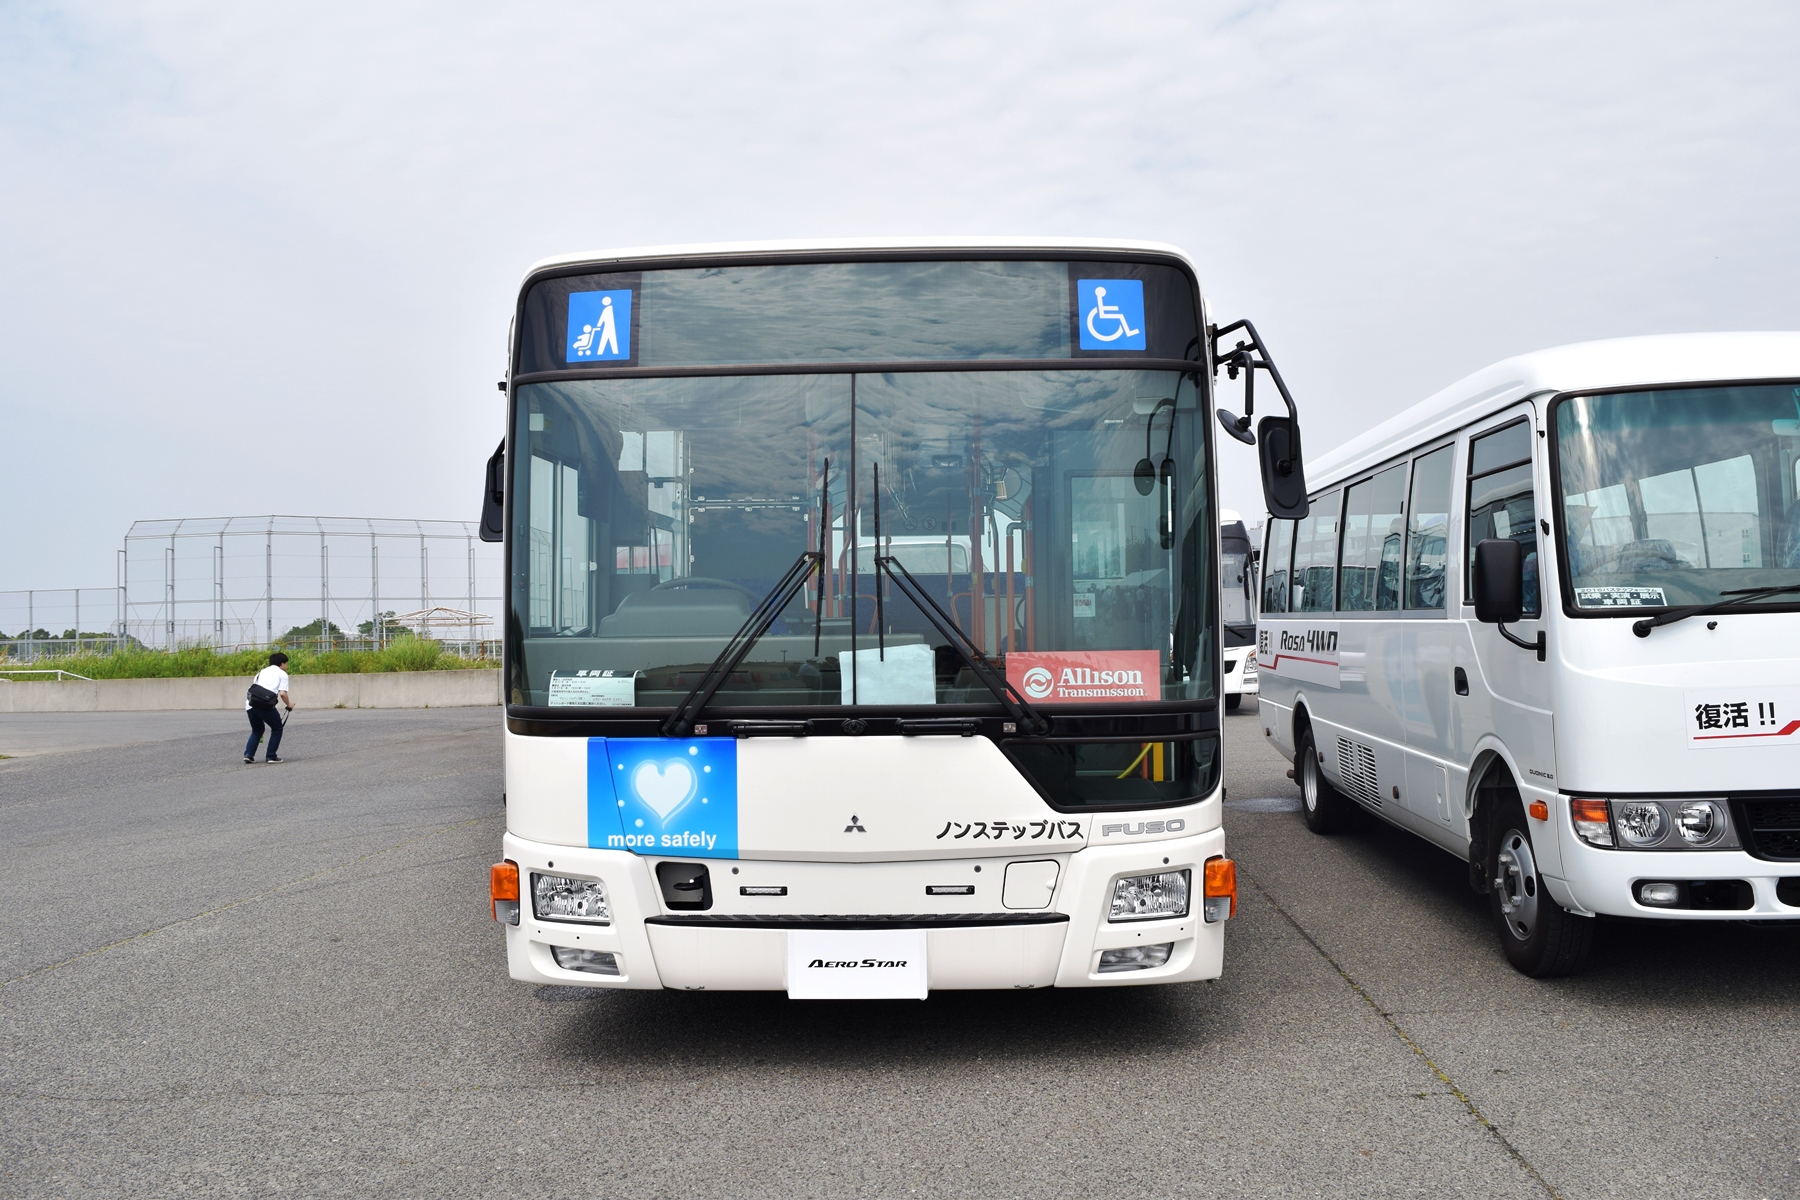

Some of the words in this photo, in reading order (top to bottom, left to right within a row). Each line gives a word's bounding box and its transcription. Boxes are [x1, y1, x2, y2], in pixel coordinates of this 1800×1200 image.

[1307, 629, 1339, 654] 4WD
[1057, 667, 1143, 685] Allison
[1057, 687, 1145, 698] Transmission
[936, 818, 1084, 841] ノンステップバス
[1102, 818, 1185, 837] FUSO
[607, 833, 655, 847] more
[660, 830, 717, 851] safely
[807, 958, 858, 968] AERO
[860, 958, 908, 968] STAR
